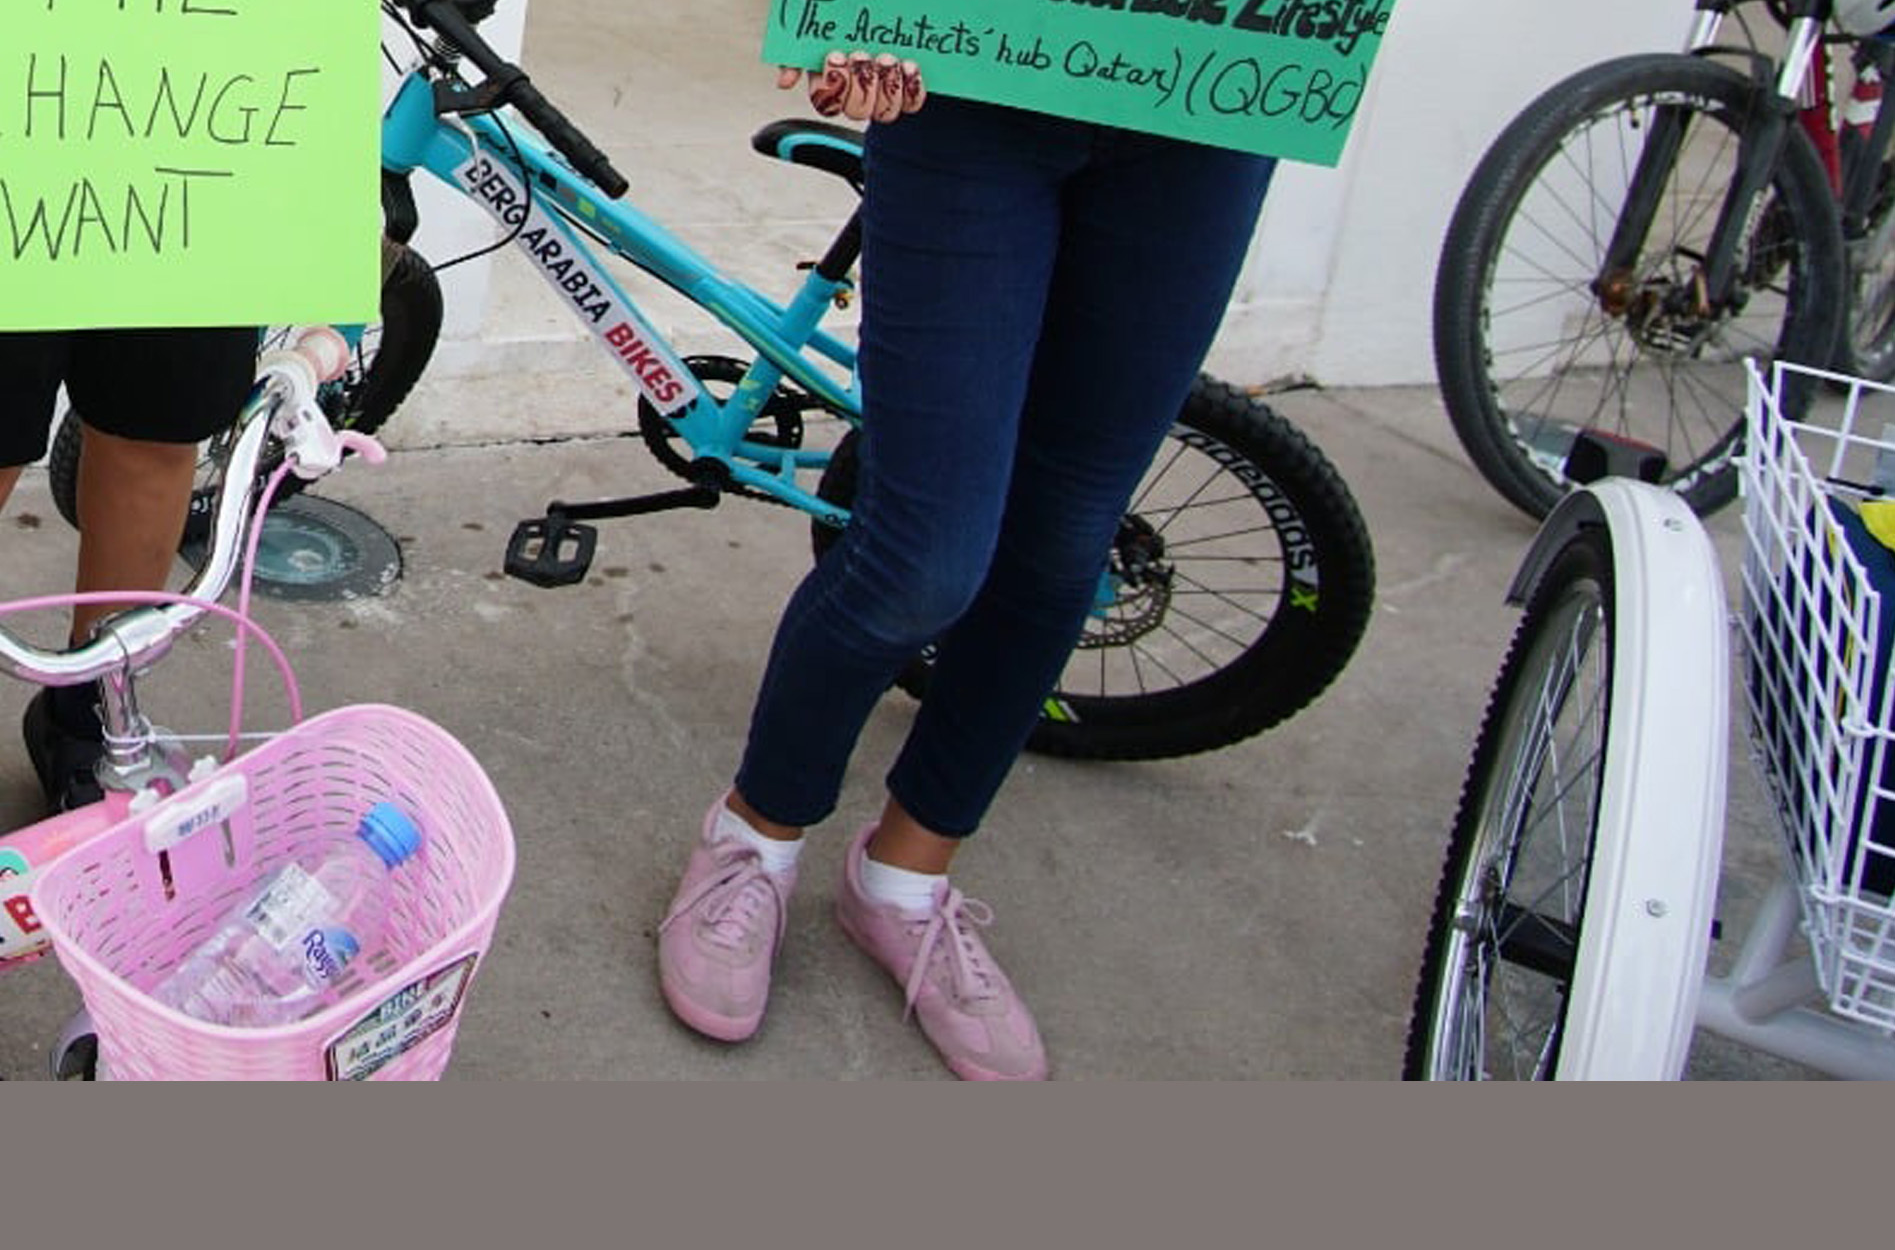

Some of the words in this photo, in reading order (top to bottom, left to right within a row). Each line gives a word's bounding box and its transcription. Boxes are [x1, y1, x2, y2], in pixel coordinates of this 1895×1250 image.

[464, 157, 528, 227] BERG
[520, 225, 613, 325] ARABIA
[602, 321, 686, 406] BIKES
